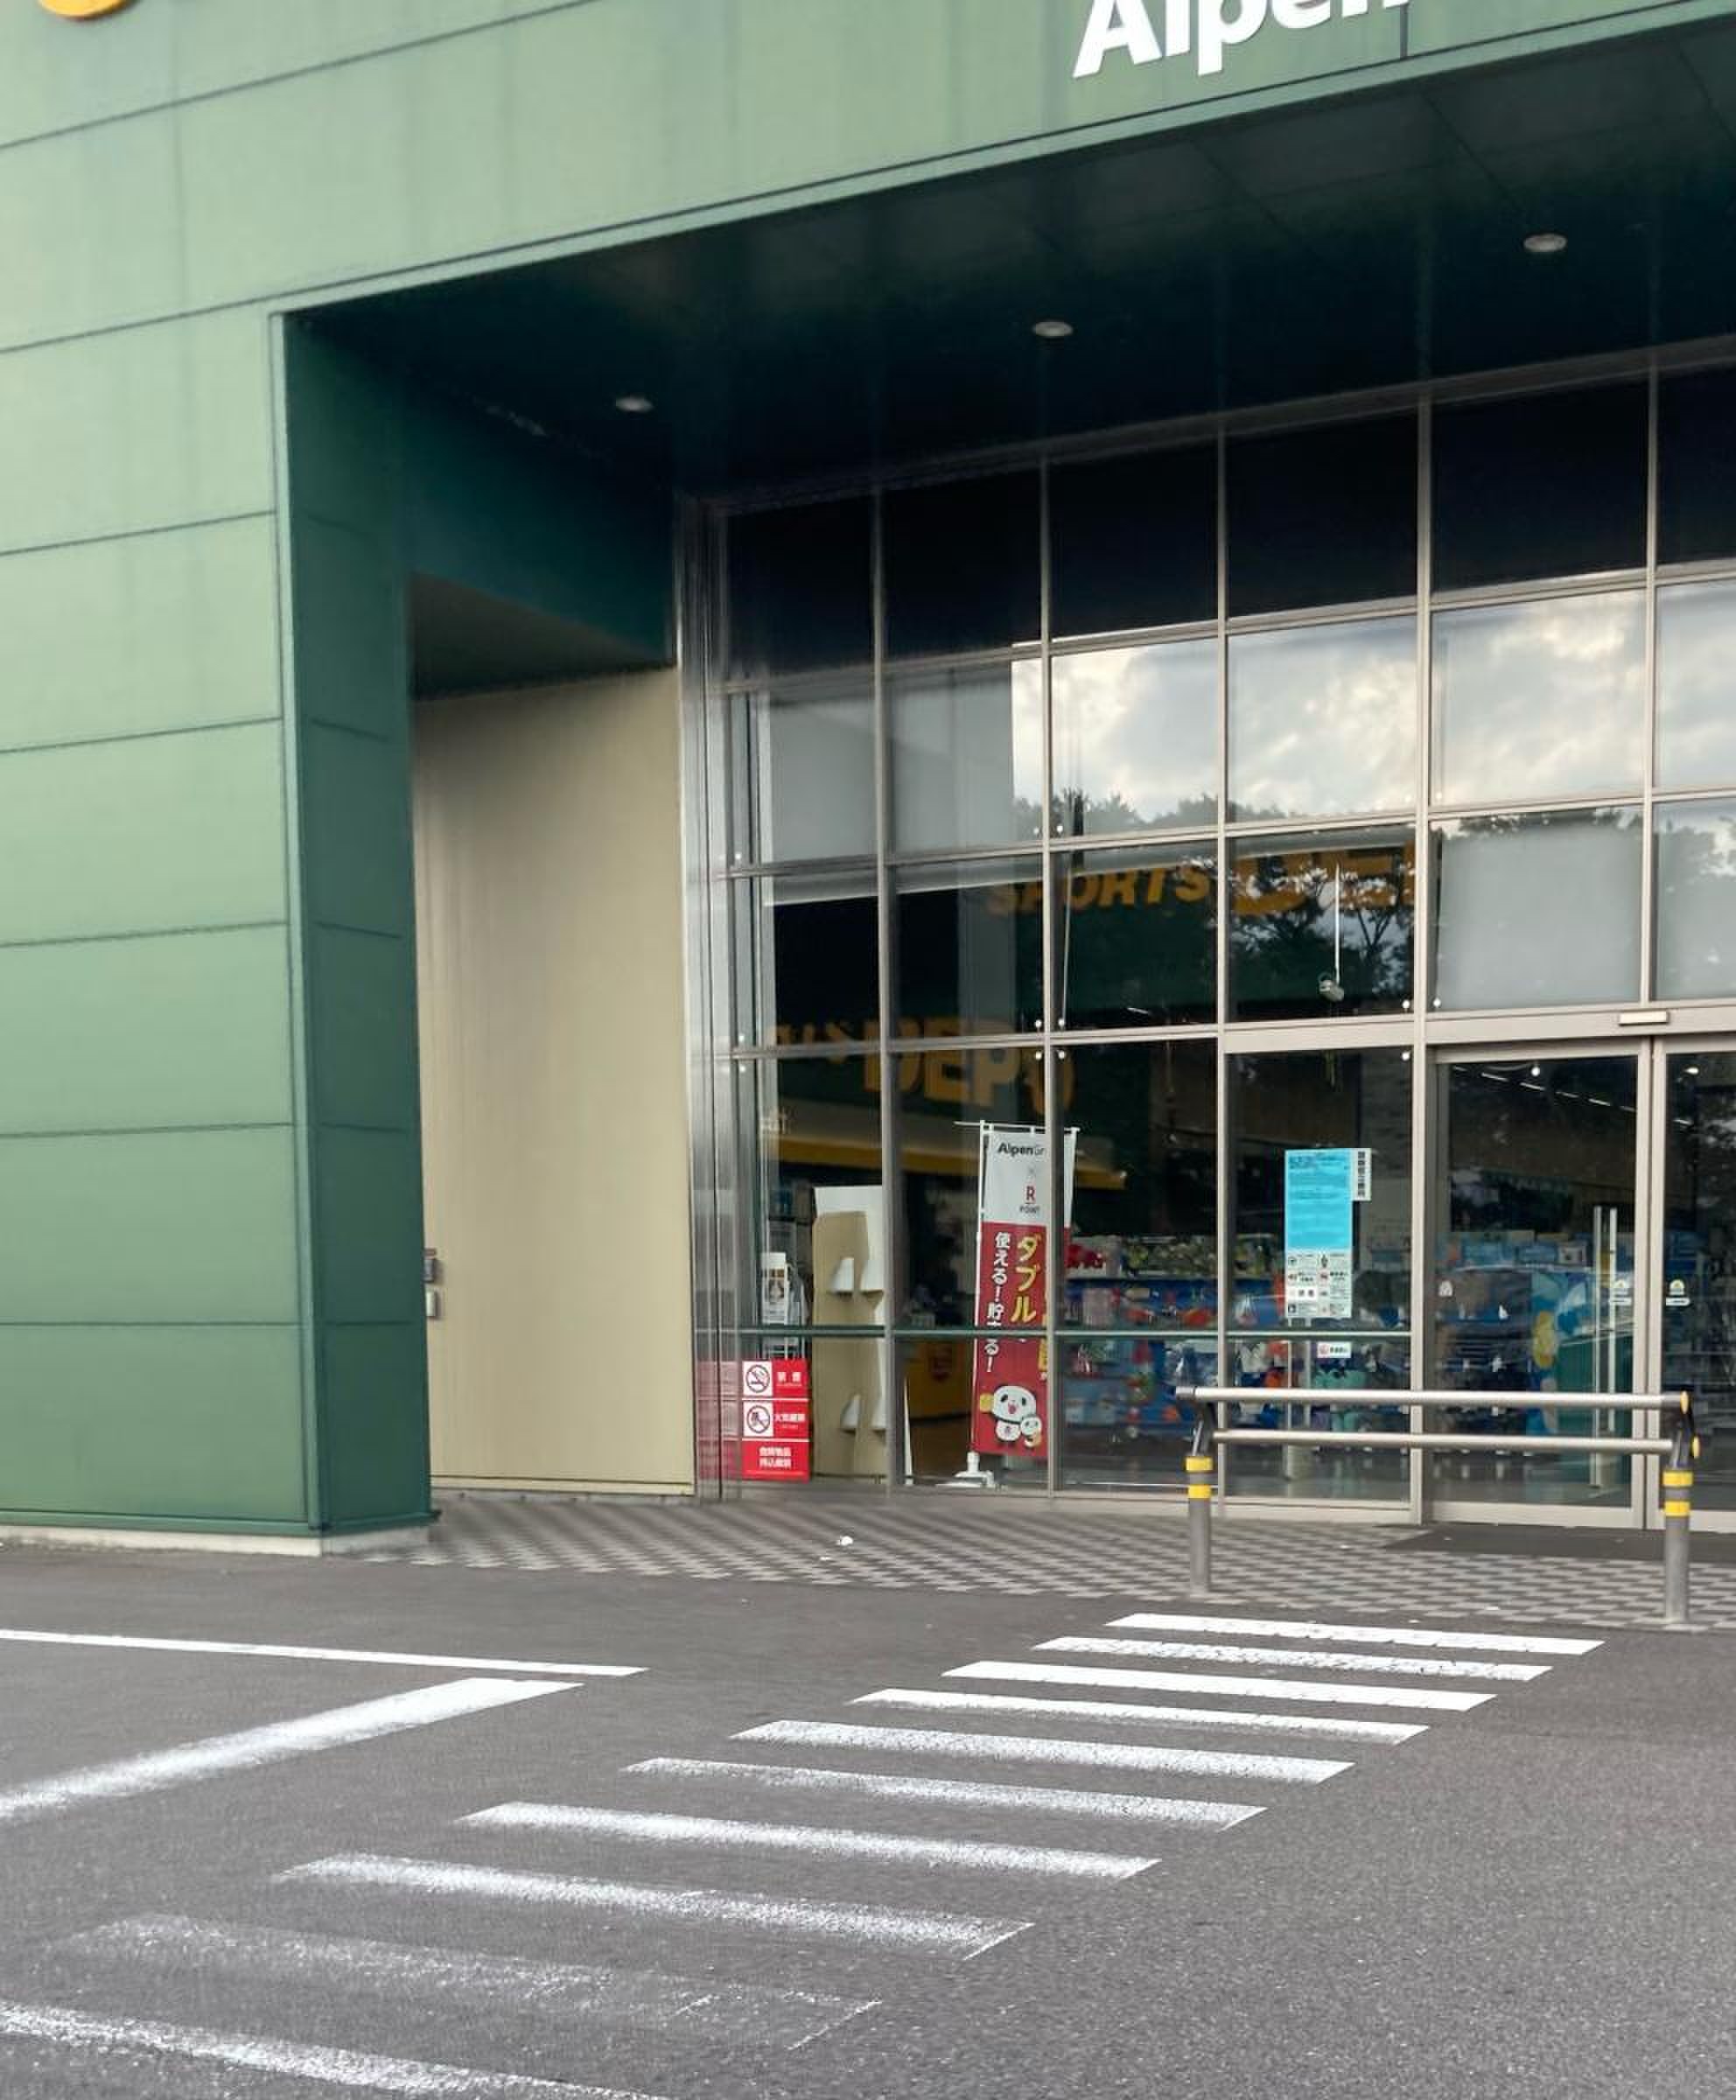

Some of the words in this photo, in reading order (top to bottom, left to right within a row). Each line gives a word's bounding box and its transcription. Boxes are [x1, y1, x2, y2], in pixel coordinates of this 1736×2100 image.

[1073, 0, 1412, 78] Alp
[1026, 1185, 1036, 1201] R
[1011, 1233, 1041, 1323] ダブル
